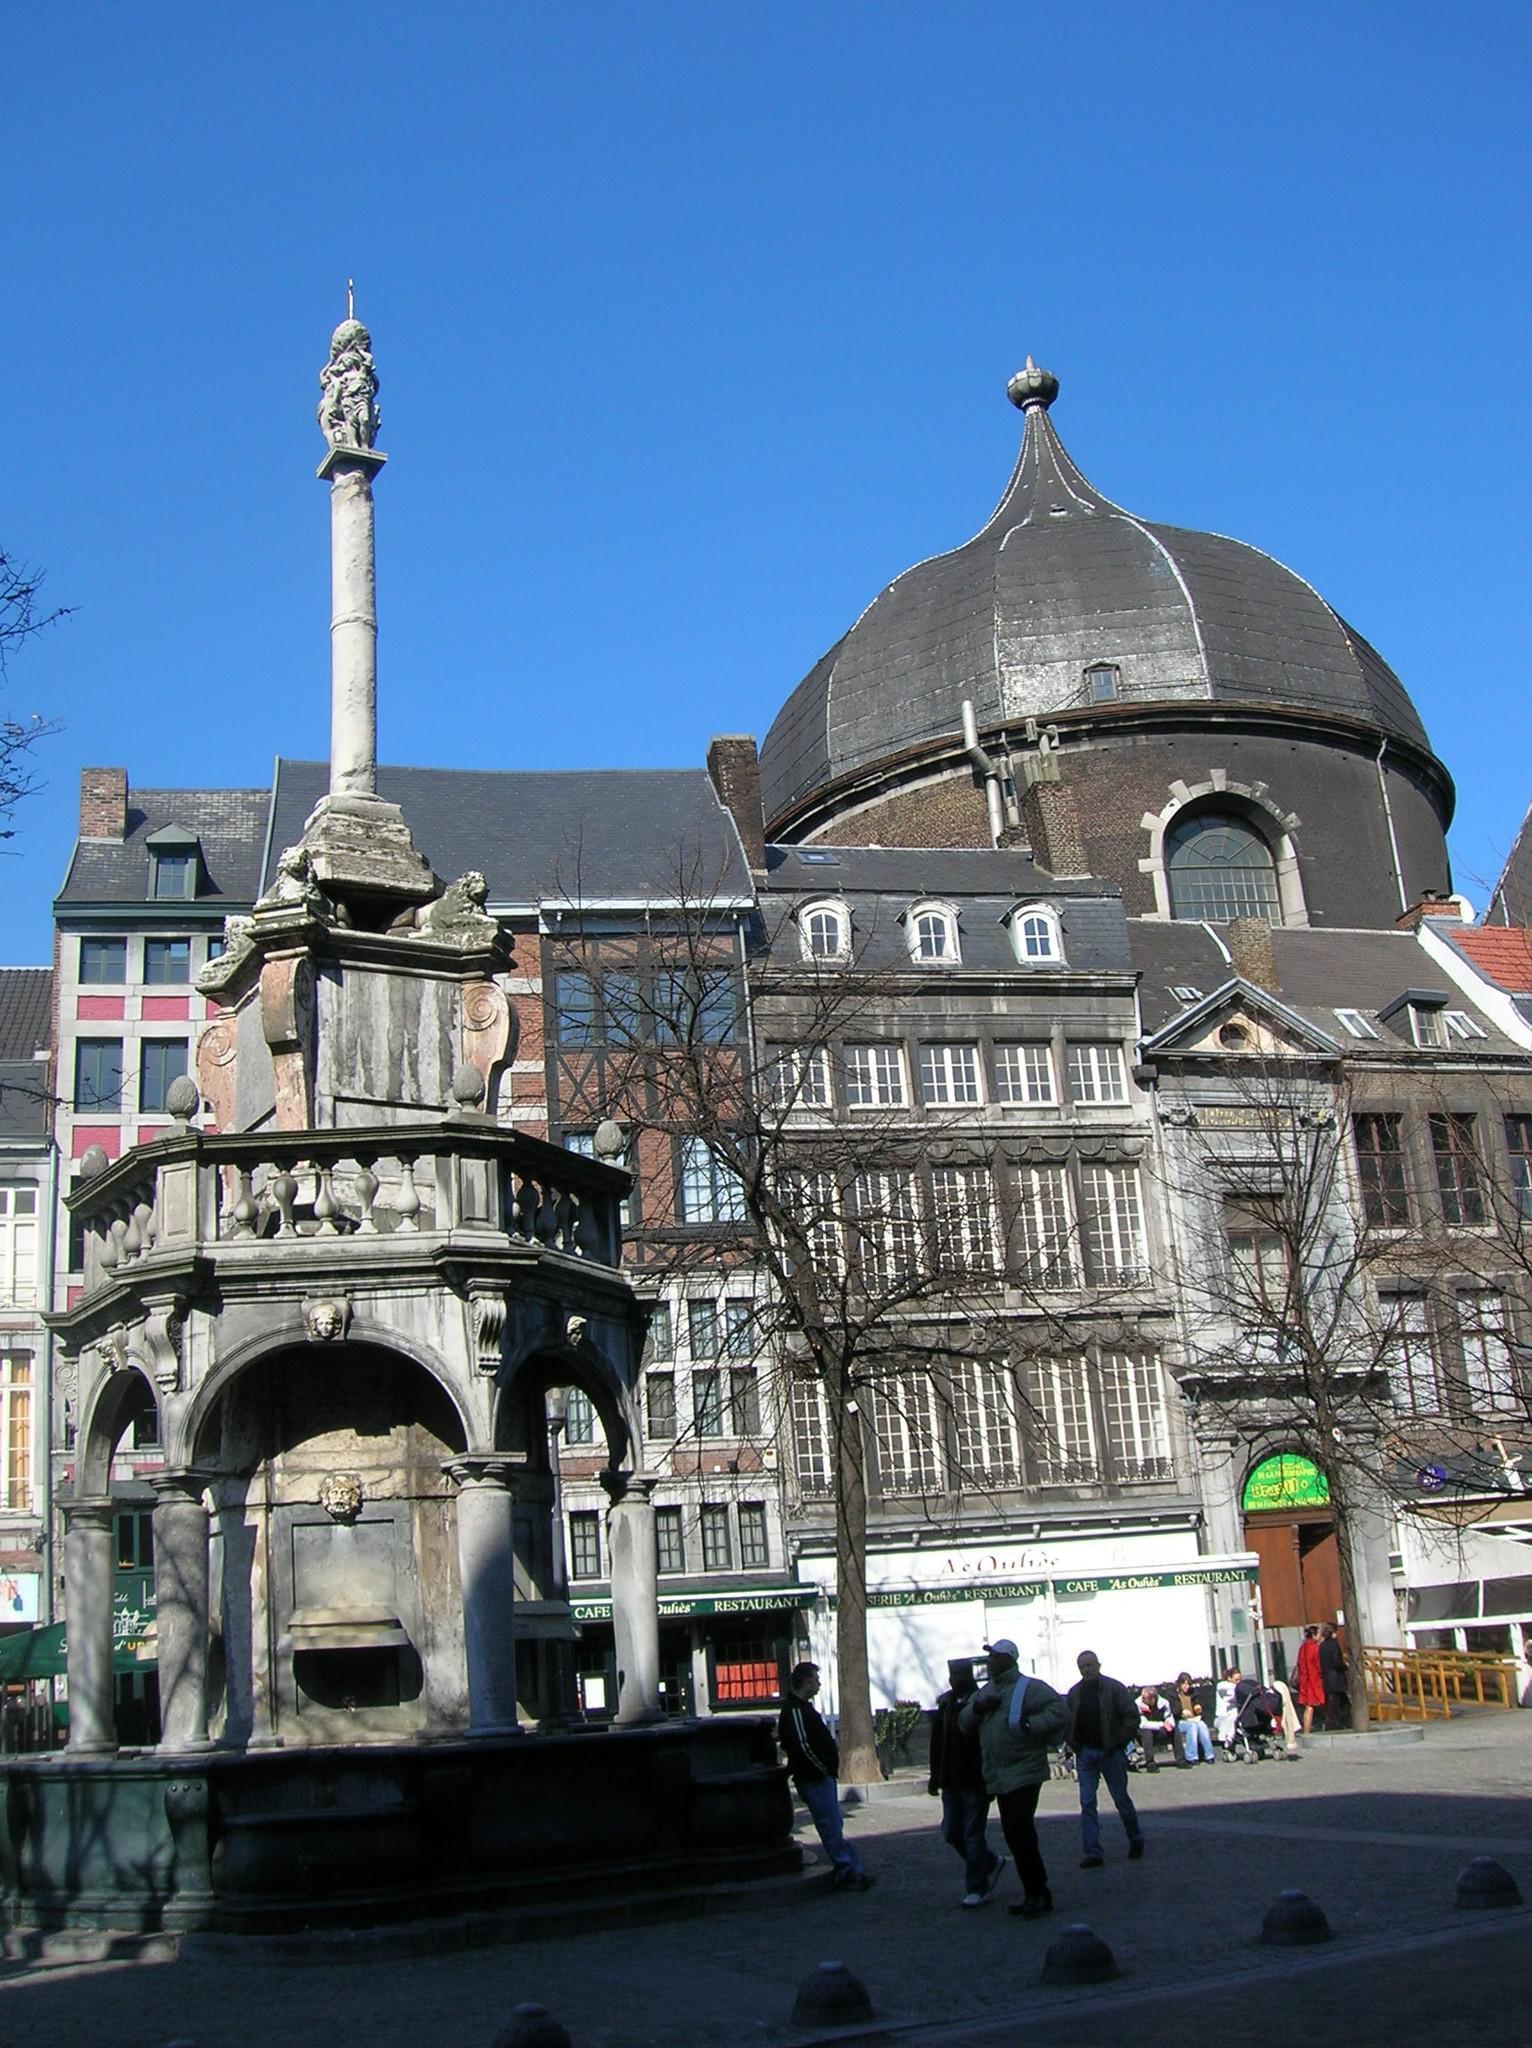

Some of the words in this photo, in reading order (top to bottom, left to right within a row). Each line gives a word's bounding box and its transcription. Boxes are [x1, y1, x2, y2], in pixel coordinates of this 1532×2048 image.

[1067, 1579, 1099, 1594] CAFE
[1174, 1569, 1248, 1586] RESTAURANT
[867, 1594, 903, 1607] SERIE
[965, 1583, 1042, 1600] RESTAURANT
[574, 1605, 611, 1619] CAFE
[714, 1597, 801, 1612] RESTAURANT
